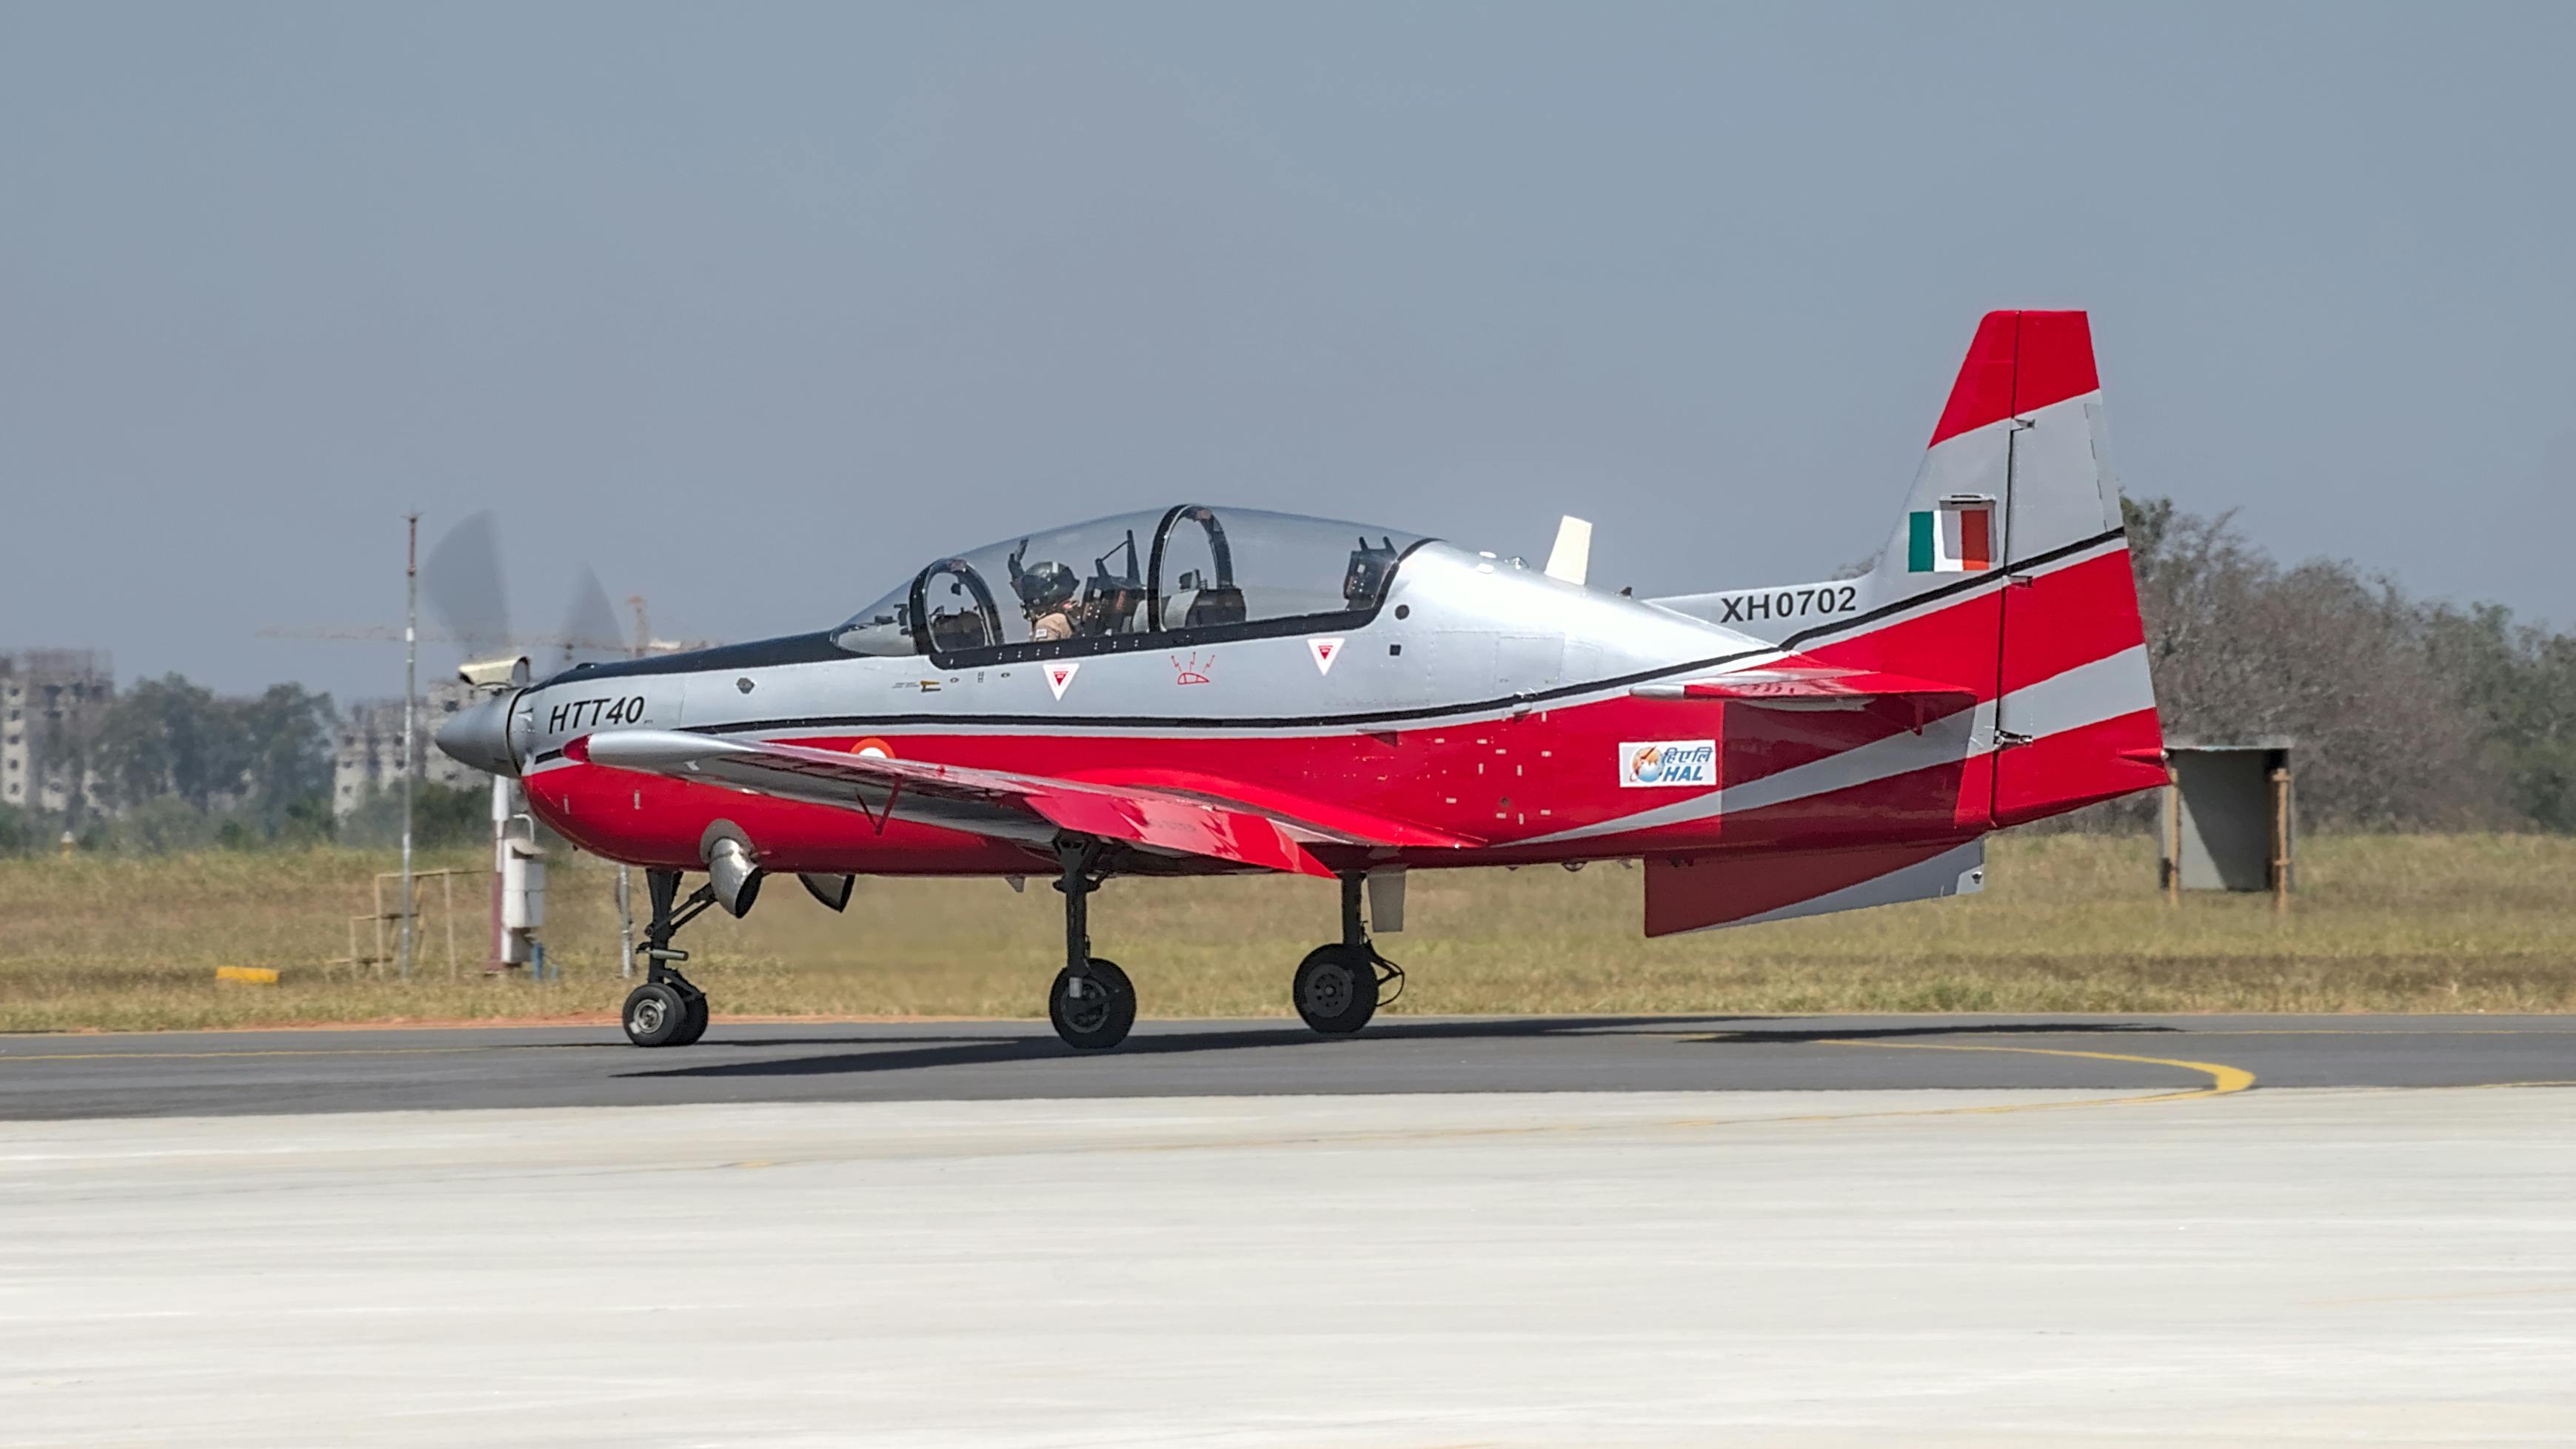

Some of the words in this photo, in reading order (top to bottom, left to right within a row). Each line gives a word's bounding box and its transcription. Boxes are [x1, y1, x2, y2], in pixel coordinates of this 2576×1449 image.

[1720, 586, 1856, 623] XH0702
[549, 696, 644, 734] HTT40
[1663, 766, 1703, 781] HAL
